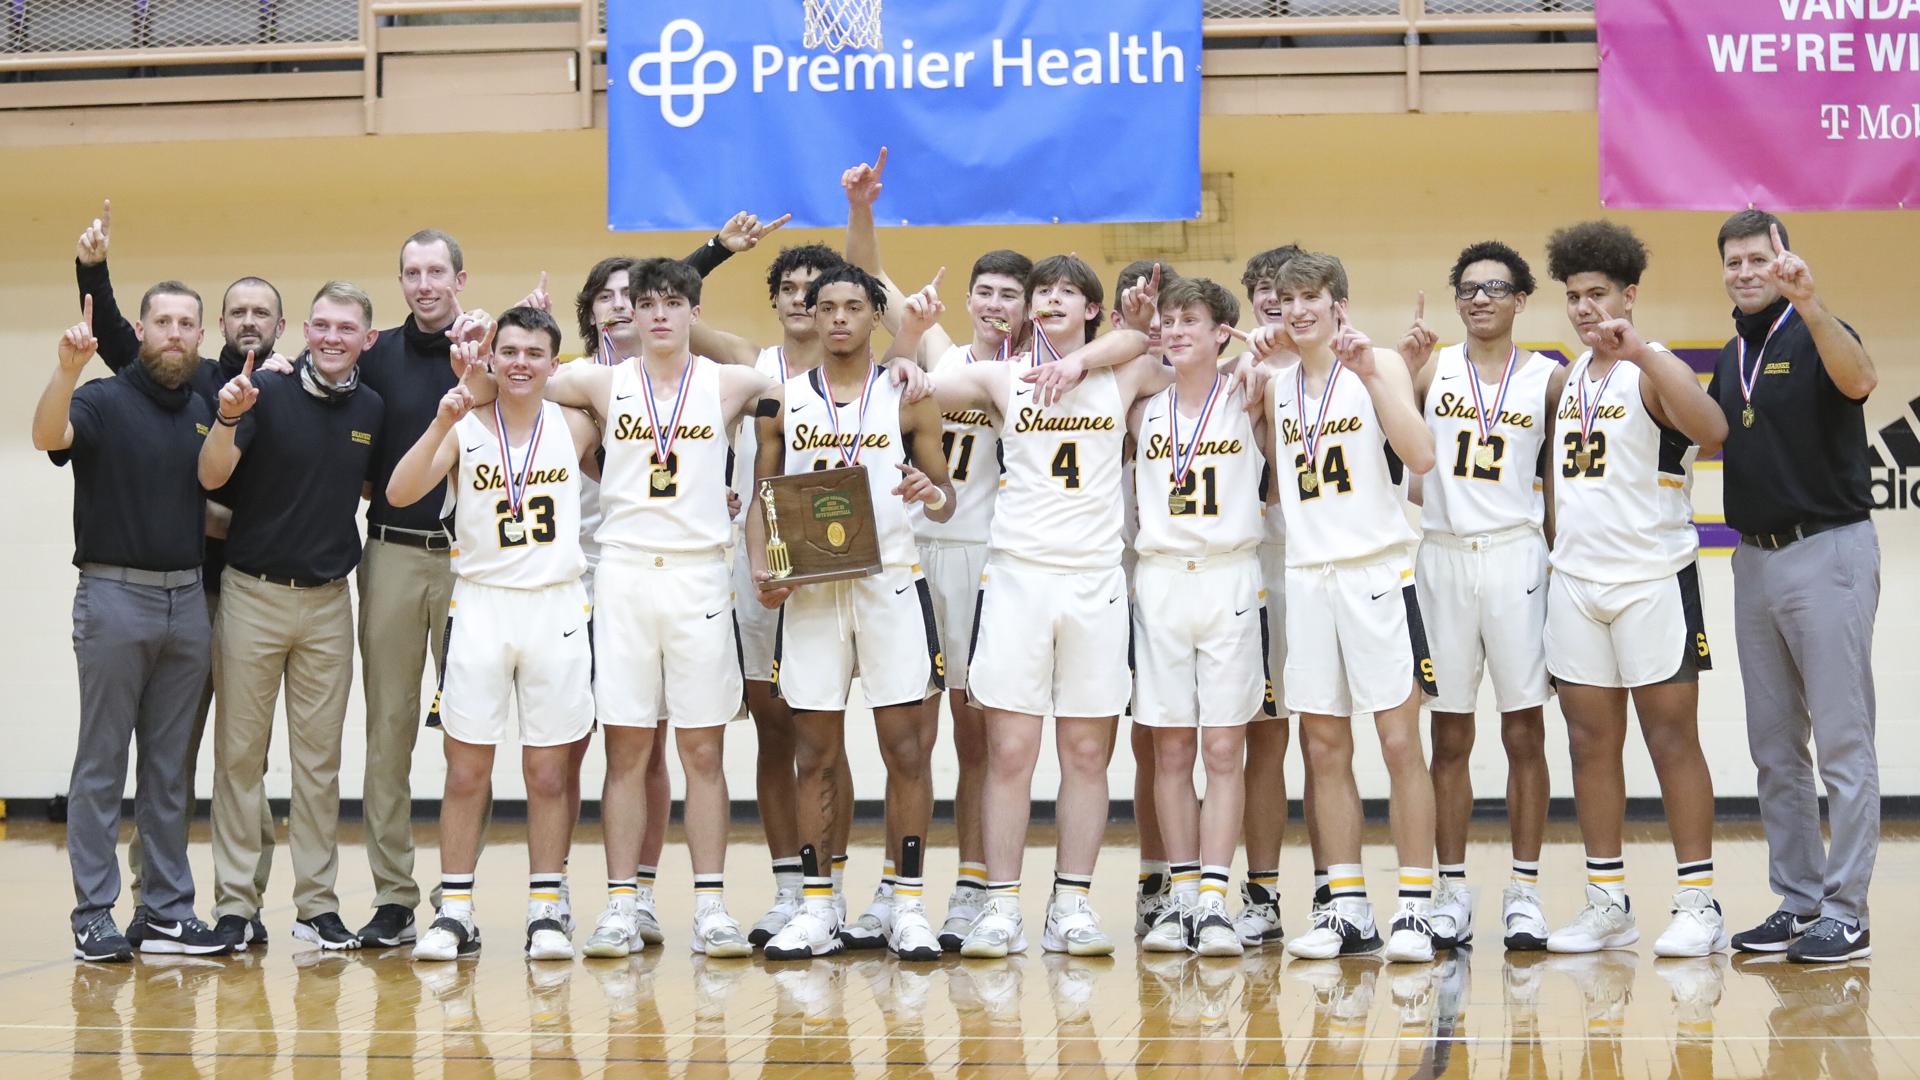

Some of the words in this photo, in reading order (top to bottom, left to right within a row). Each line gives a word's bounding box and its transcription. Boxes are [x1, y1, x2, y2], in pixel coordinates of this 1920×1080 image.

[753, 39, 975, 94] Premier
[992, 31, 1185, 88] Health
[1707, 33, 1856, 72] WE'RE
[1864, 33, 1918, 72] WI
[1015, 407, 1115, 433] Shawnee
[1281, 416, 1362, 446] Shwnee
[1558, 395, 1627, 420] Shanee
[473, 464, 569, 491] Shwnee
[648, 449, 681, 499] 2
[1050, 439, 1081, 490] 4
[1294, 444, 1353, 502] 24
[1453, 427, 1506, 482] 12
[1562, 430, 1606, 478] 32
[1167, 465, 1218, 517] 21
[496, 495, 557, 549] 23
[1696, 632, 1709, 657] S
[1420, 658, 1436, 682] S
